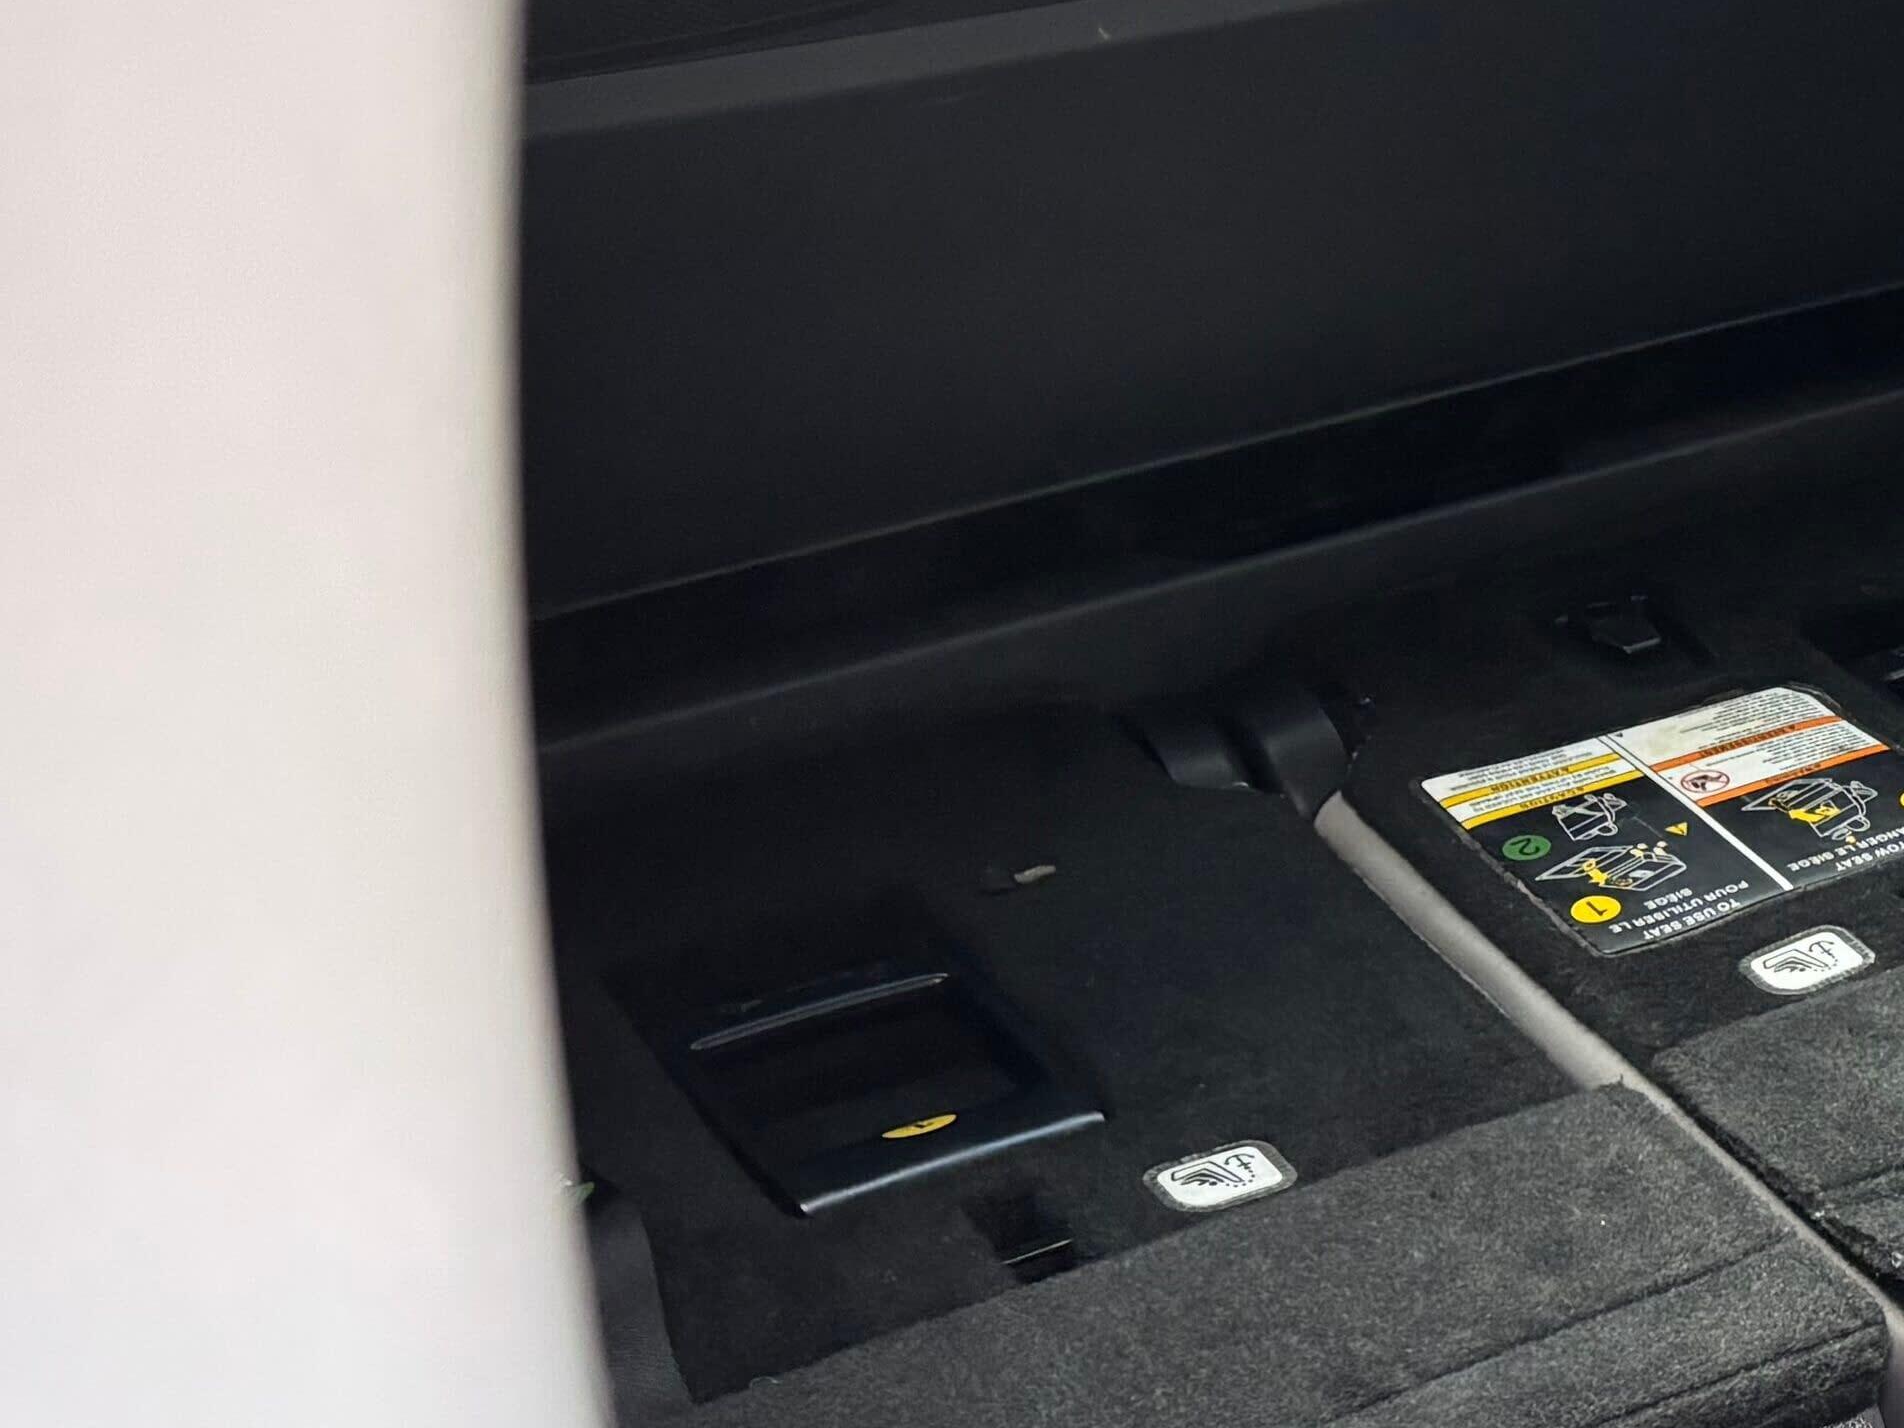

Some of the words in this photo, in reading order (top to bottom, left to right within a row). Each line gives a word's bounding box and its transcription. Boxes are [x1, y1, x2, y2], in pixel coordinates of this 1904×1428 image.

[1510, 837, 1541, 856] 2
[1835, 845, 1857, 857] LE
[1835, 852, 1874, 872] SEAT
[1703, 879, 1749, 902] POUR
[1587, 900, 1607, 917] 1
[1631, 897, 1704, 928] UTILISER
[1717, 898, 1741, 912] TO
[1682, 908, 1717, 927] USE
[1608, 921, 1633, 934] LE
[1643, 922, 1682, 940] SEAT
